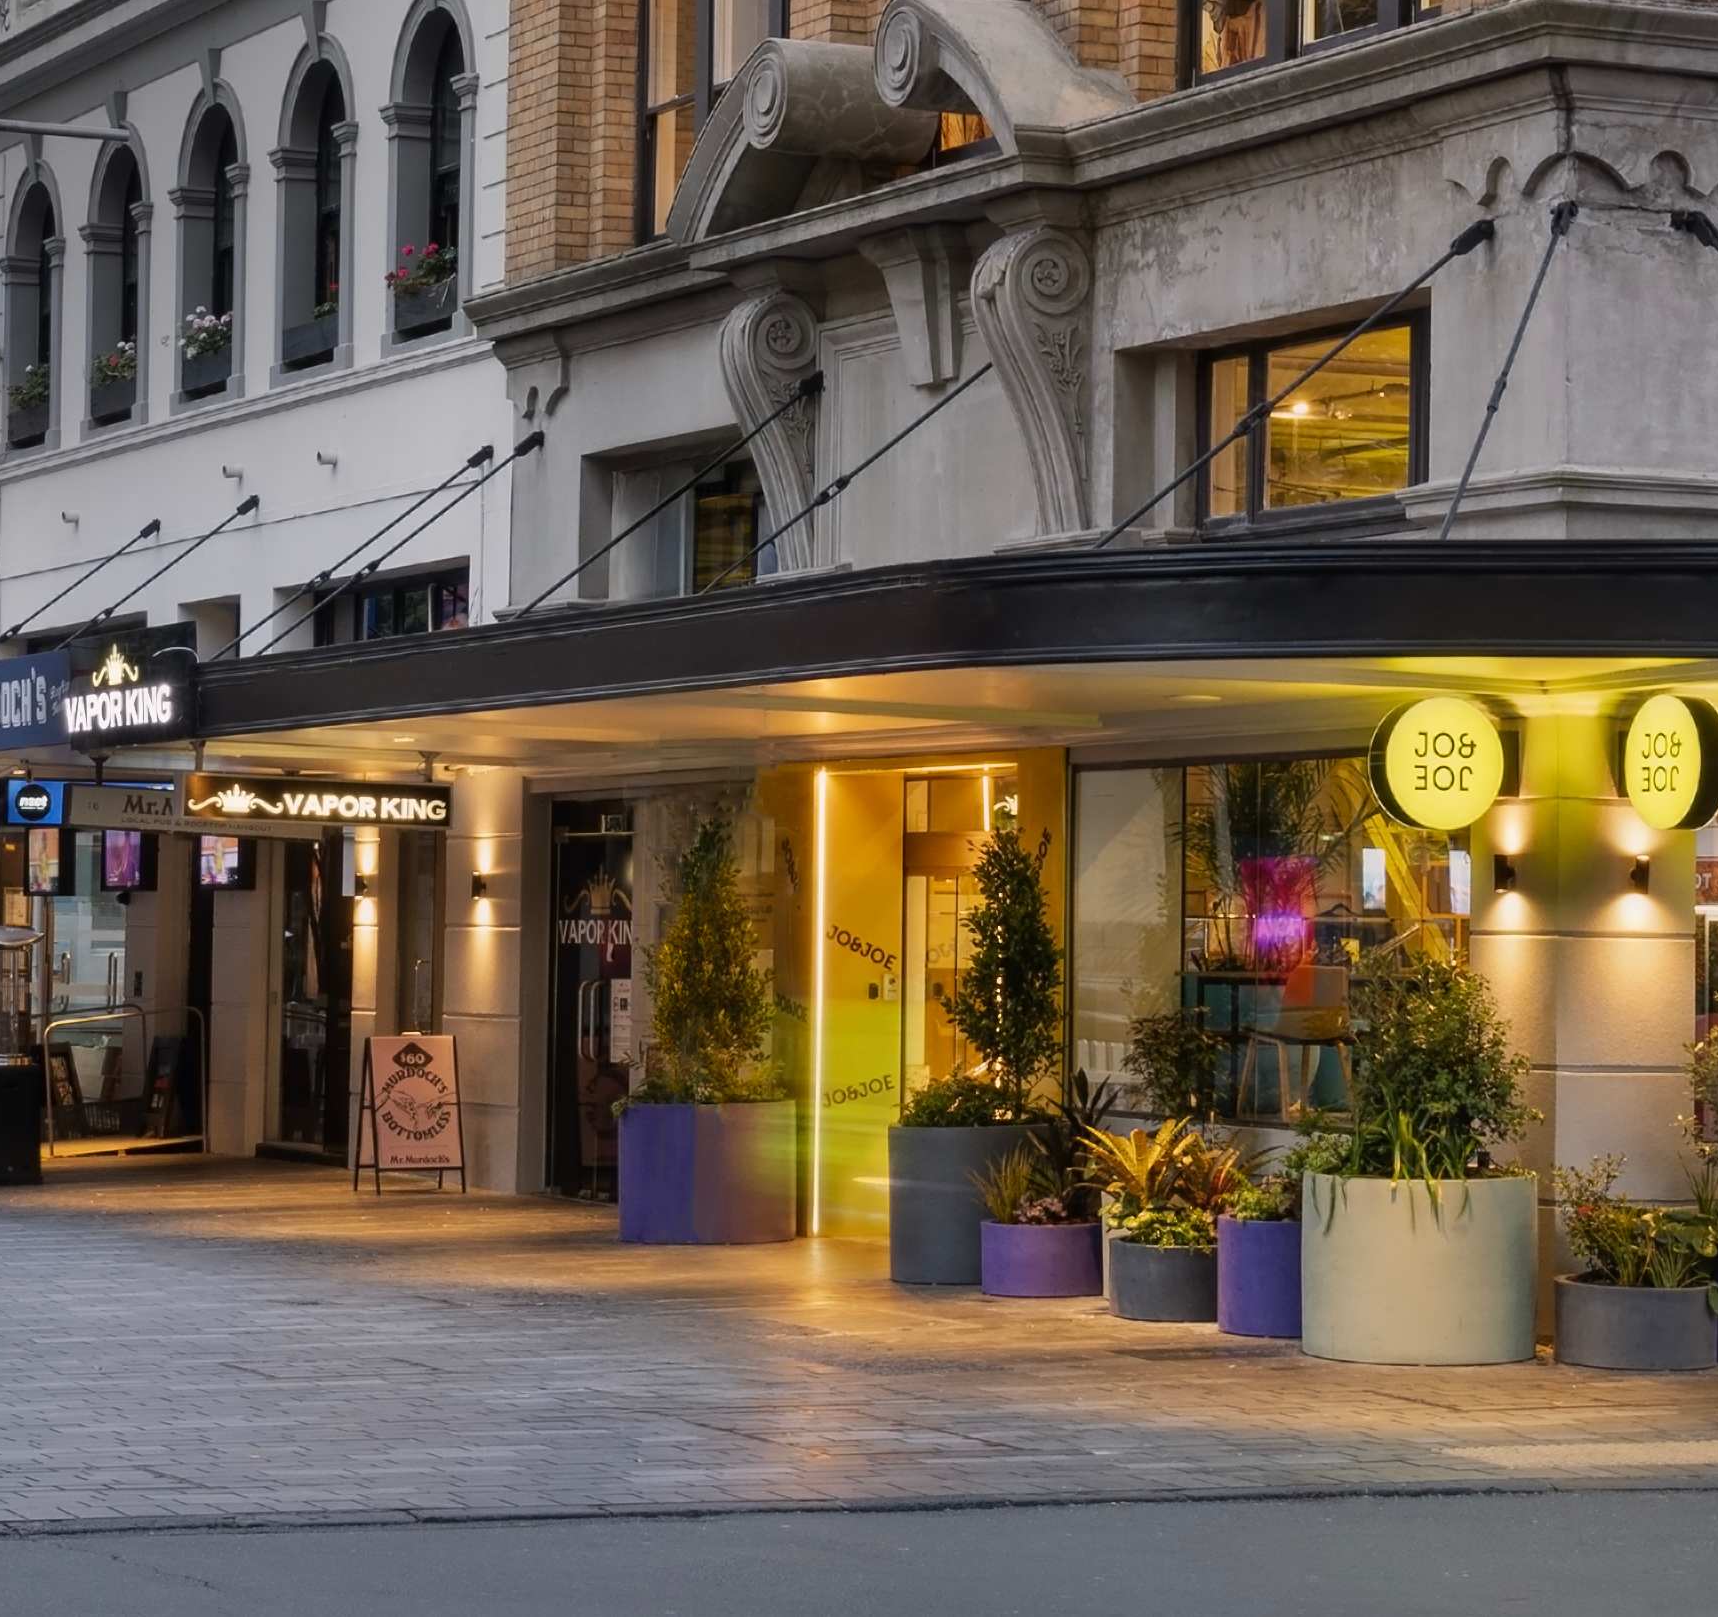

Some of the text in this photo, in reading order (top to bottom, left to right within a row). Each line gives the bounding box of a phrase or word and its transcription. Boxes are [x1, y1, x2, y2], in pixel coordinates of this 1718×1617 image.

[66, 691, 123, 733] VAPOR
[125, 684, 173, 727] KING
[1414, 732, 1477, 760] JO&
[1642, 732, 1682, 759] JO&
[1414, 765, 1473, 792] JOE
[1642, 766, 1679, 792] JOE
[283, 793, 447, 820] VAPOR KING
[559, 920, 605, 944] VAPOR
[826, 923, 898, 972] JO&JOE
[382, 1066, 449, 1094] MURDOCH'S
[822, 1074, 895, 1110] JO&JOE
[382, 1110, 451, 1142] BOTTOMLESS
